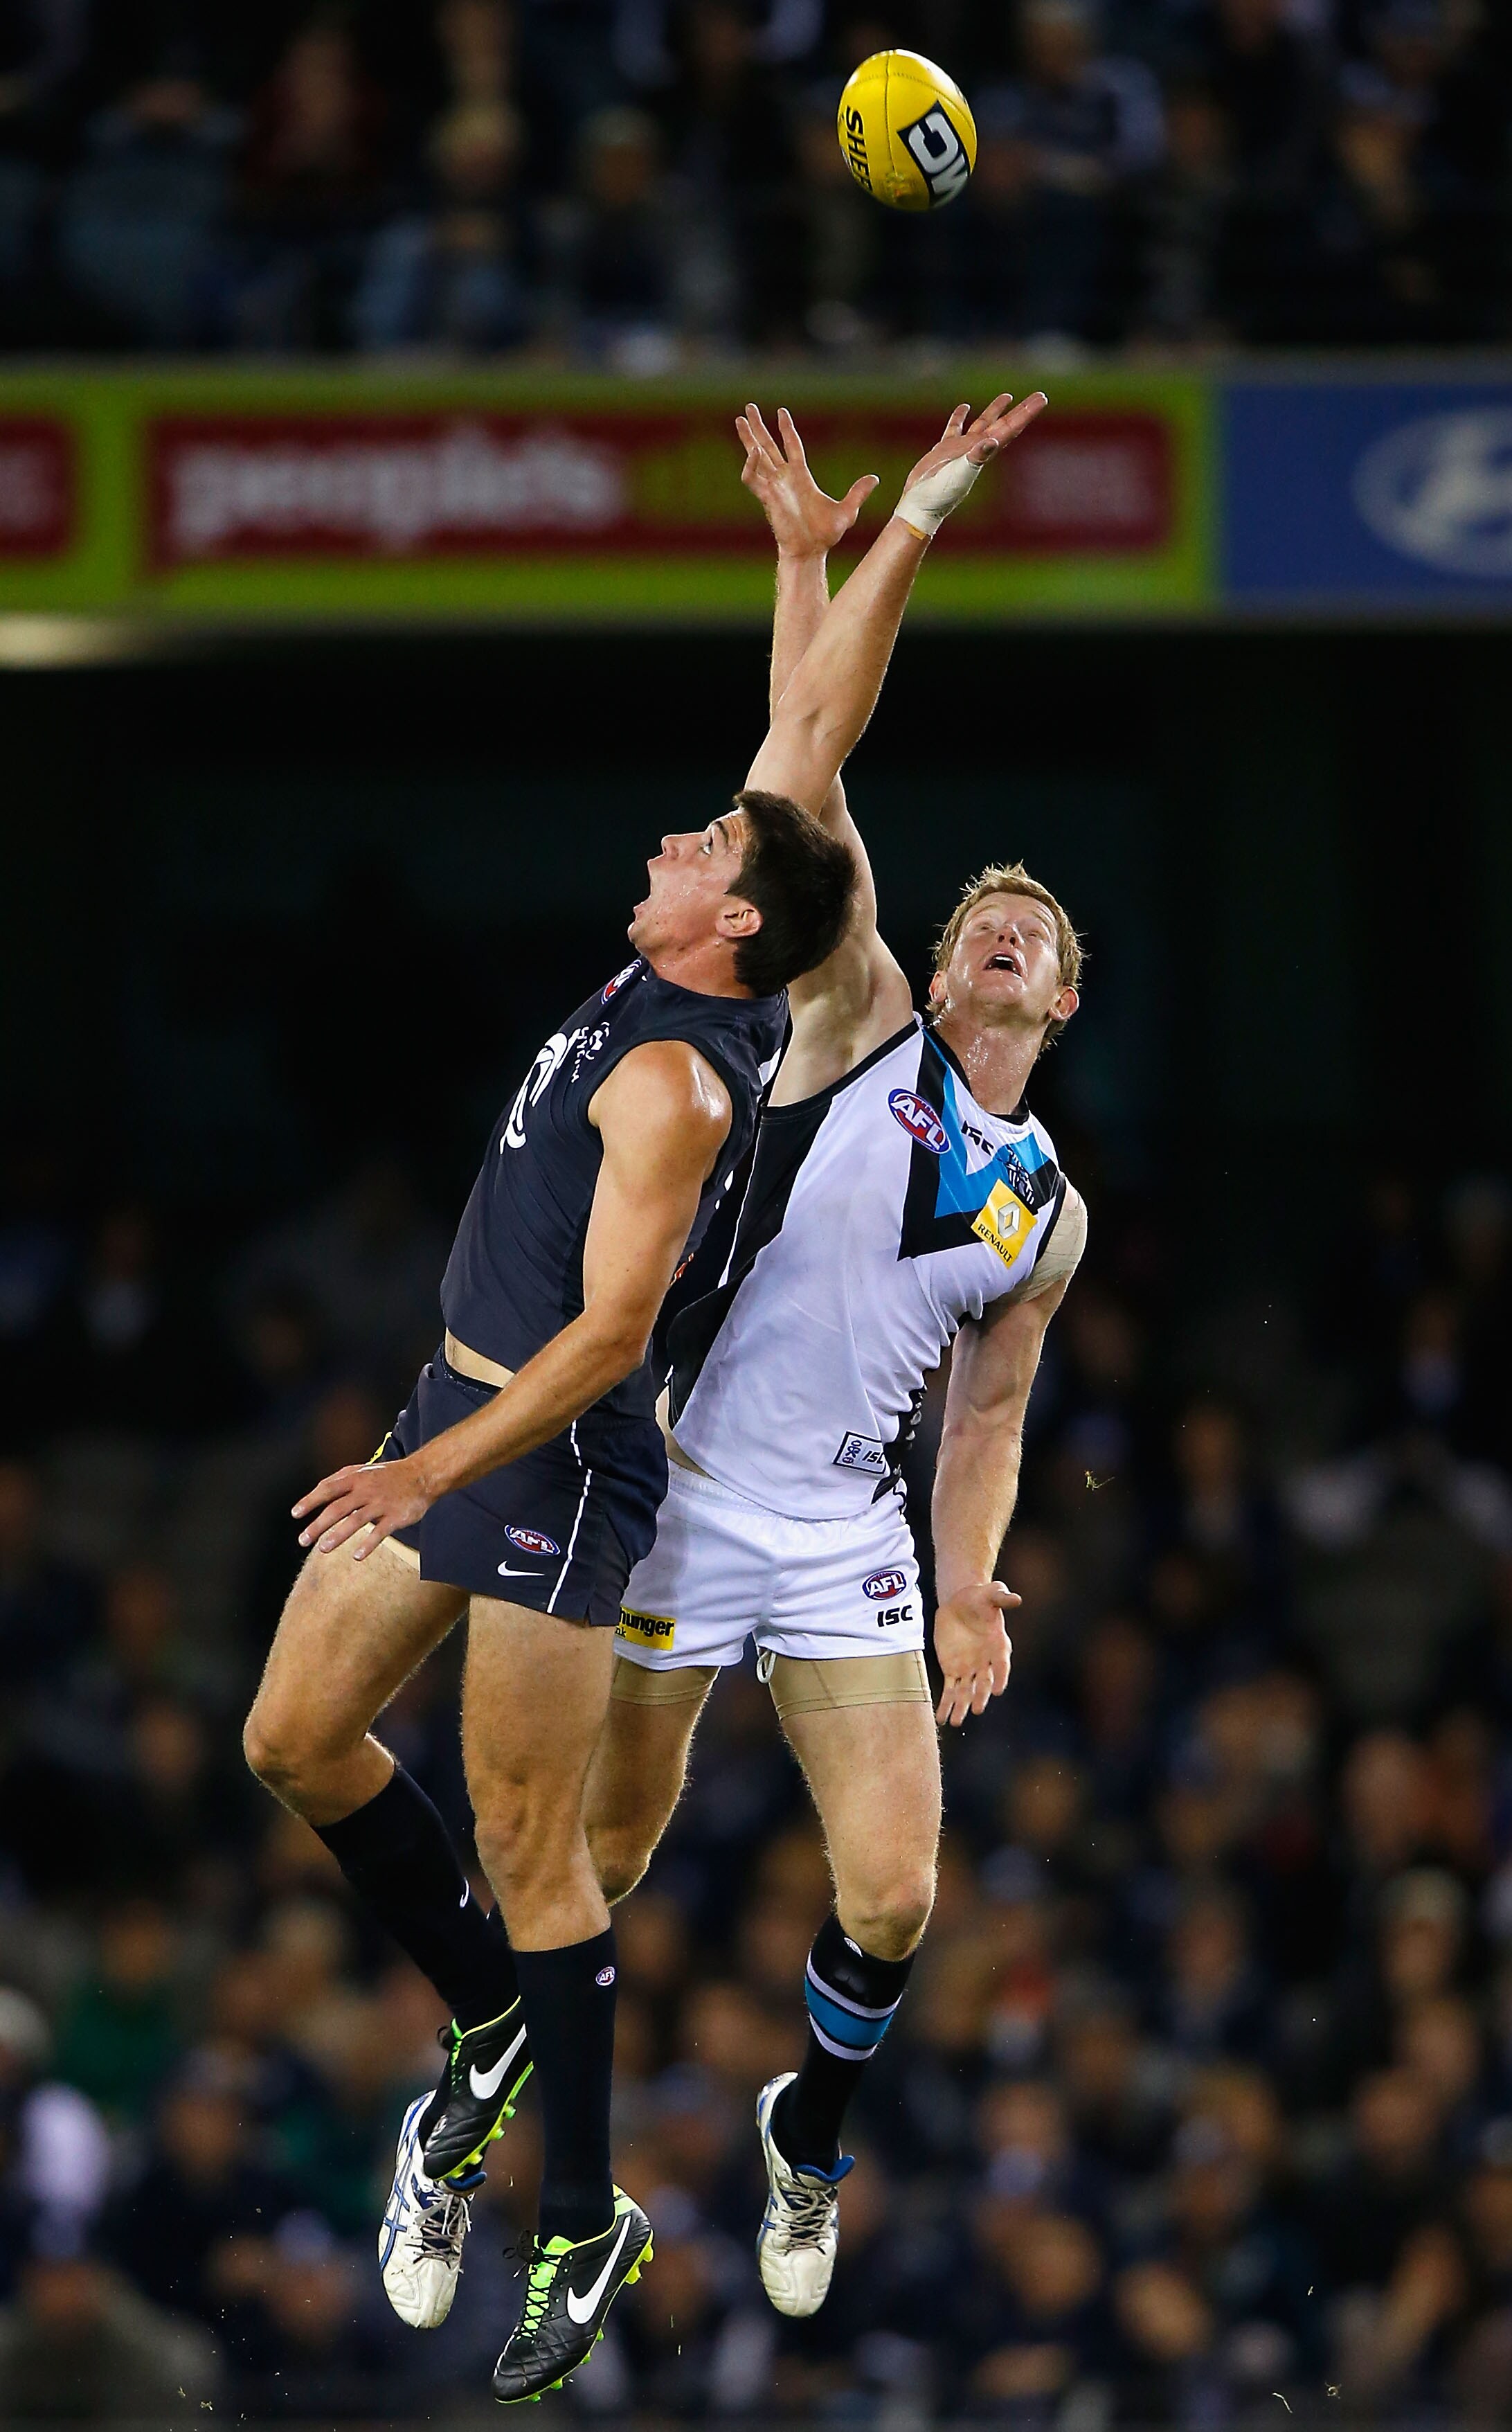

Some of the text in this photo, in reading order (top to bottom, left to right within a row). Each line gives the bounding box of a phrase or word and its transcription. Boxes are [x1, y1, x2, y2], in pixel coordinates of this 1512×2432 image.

[891, 1097, 942, 1150] AFL
[978, 1224, 1012, 1262] RENAULT
[510, 1530, 554, 1554] AFL
[869, 1574, 905, 1596] AFL
[877, 1604, 913, 1627] ISC
[598, 1971, 614, 1982] AFL
